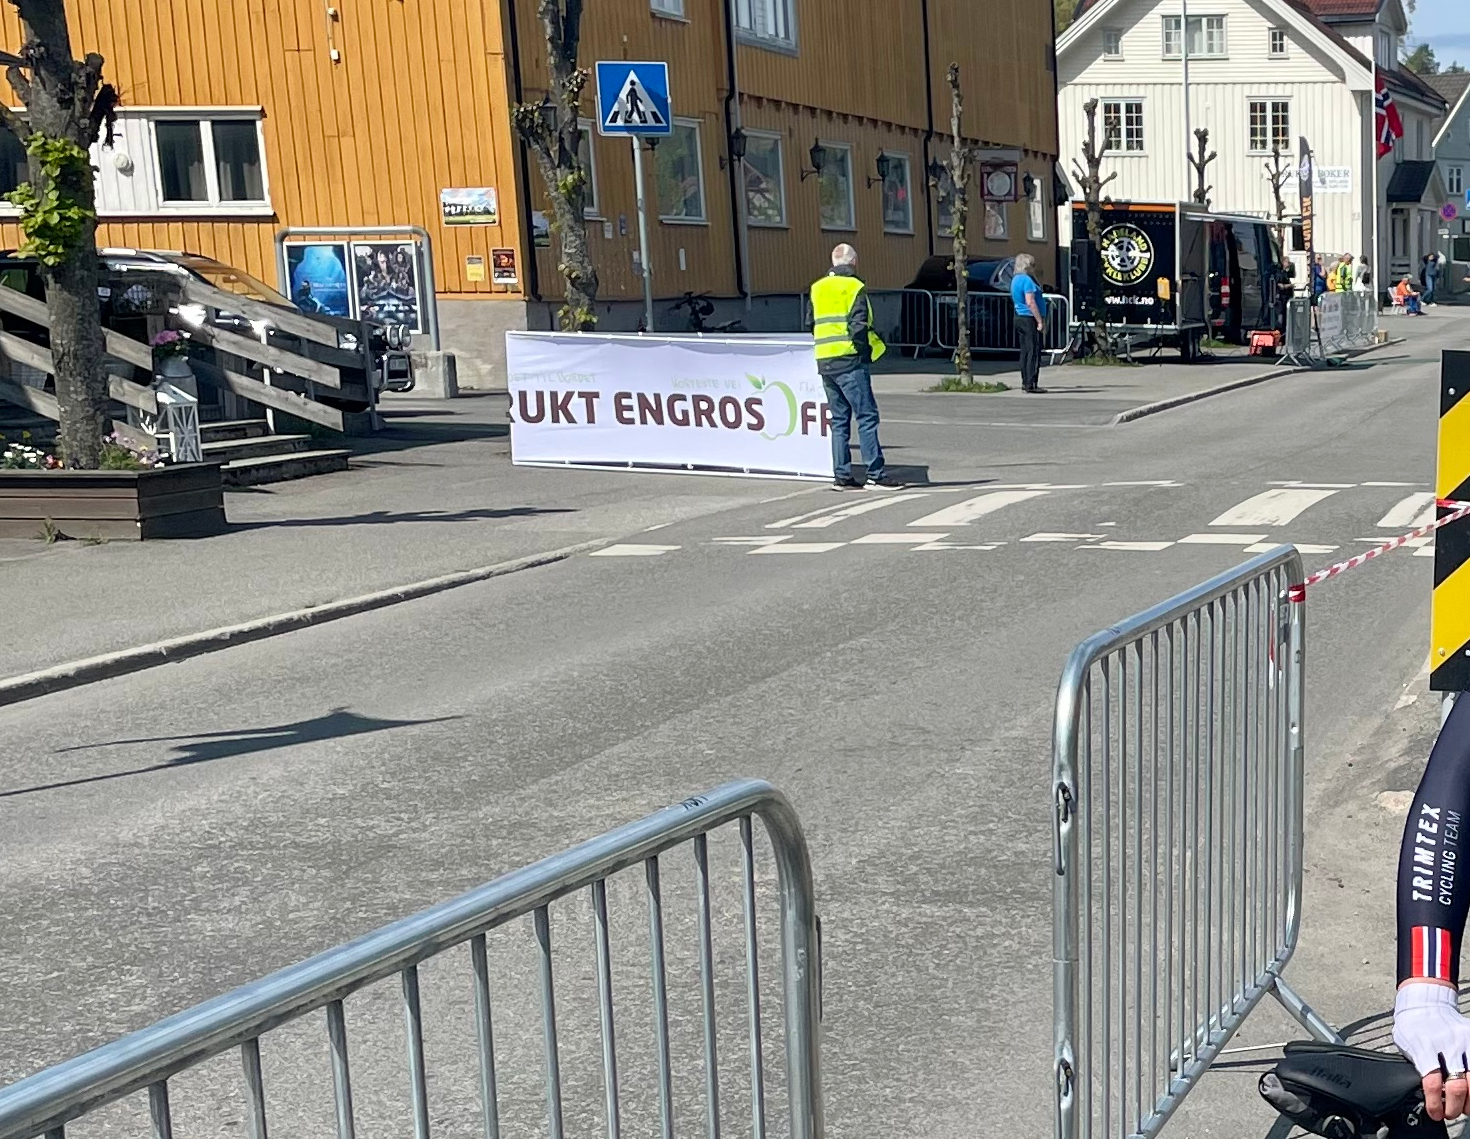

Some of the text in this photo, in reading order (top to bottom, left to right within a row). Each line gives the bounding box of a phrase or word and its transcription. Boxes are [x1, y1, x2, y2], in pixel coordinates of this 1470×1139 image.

[614, 391, 765, 431] ENGROS
[1413, 803, 1441, 902] TRIMTEX
[1438, 810, 1462, 906] CYCLING TEAM
